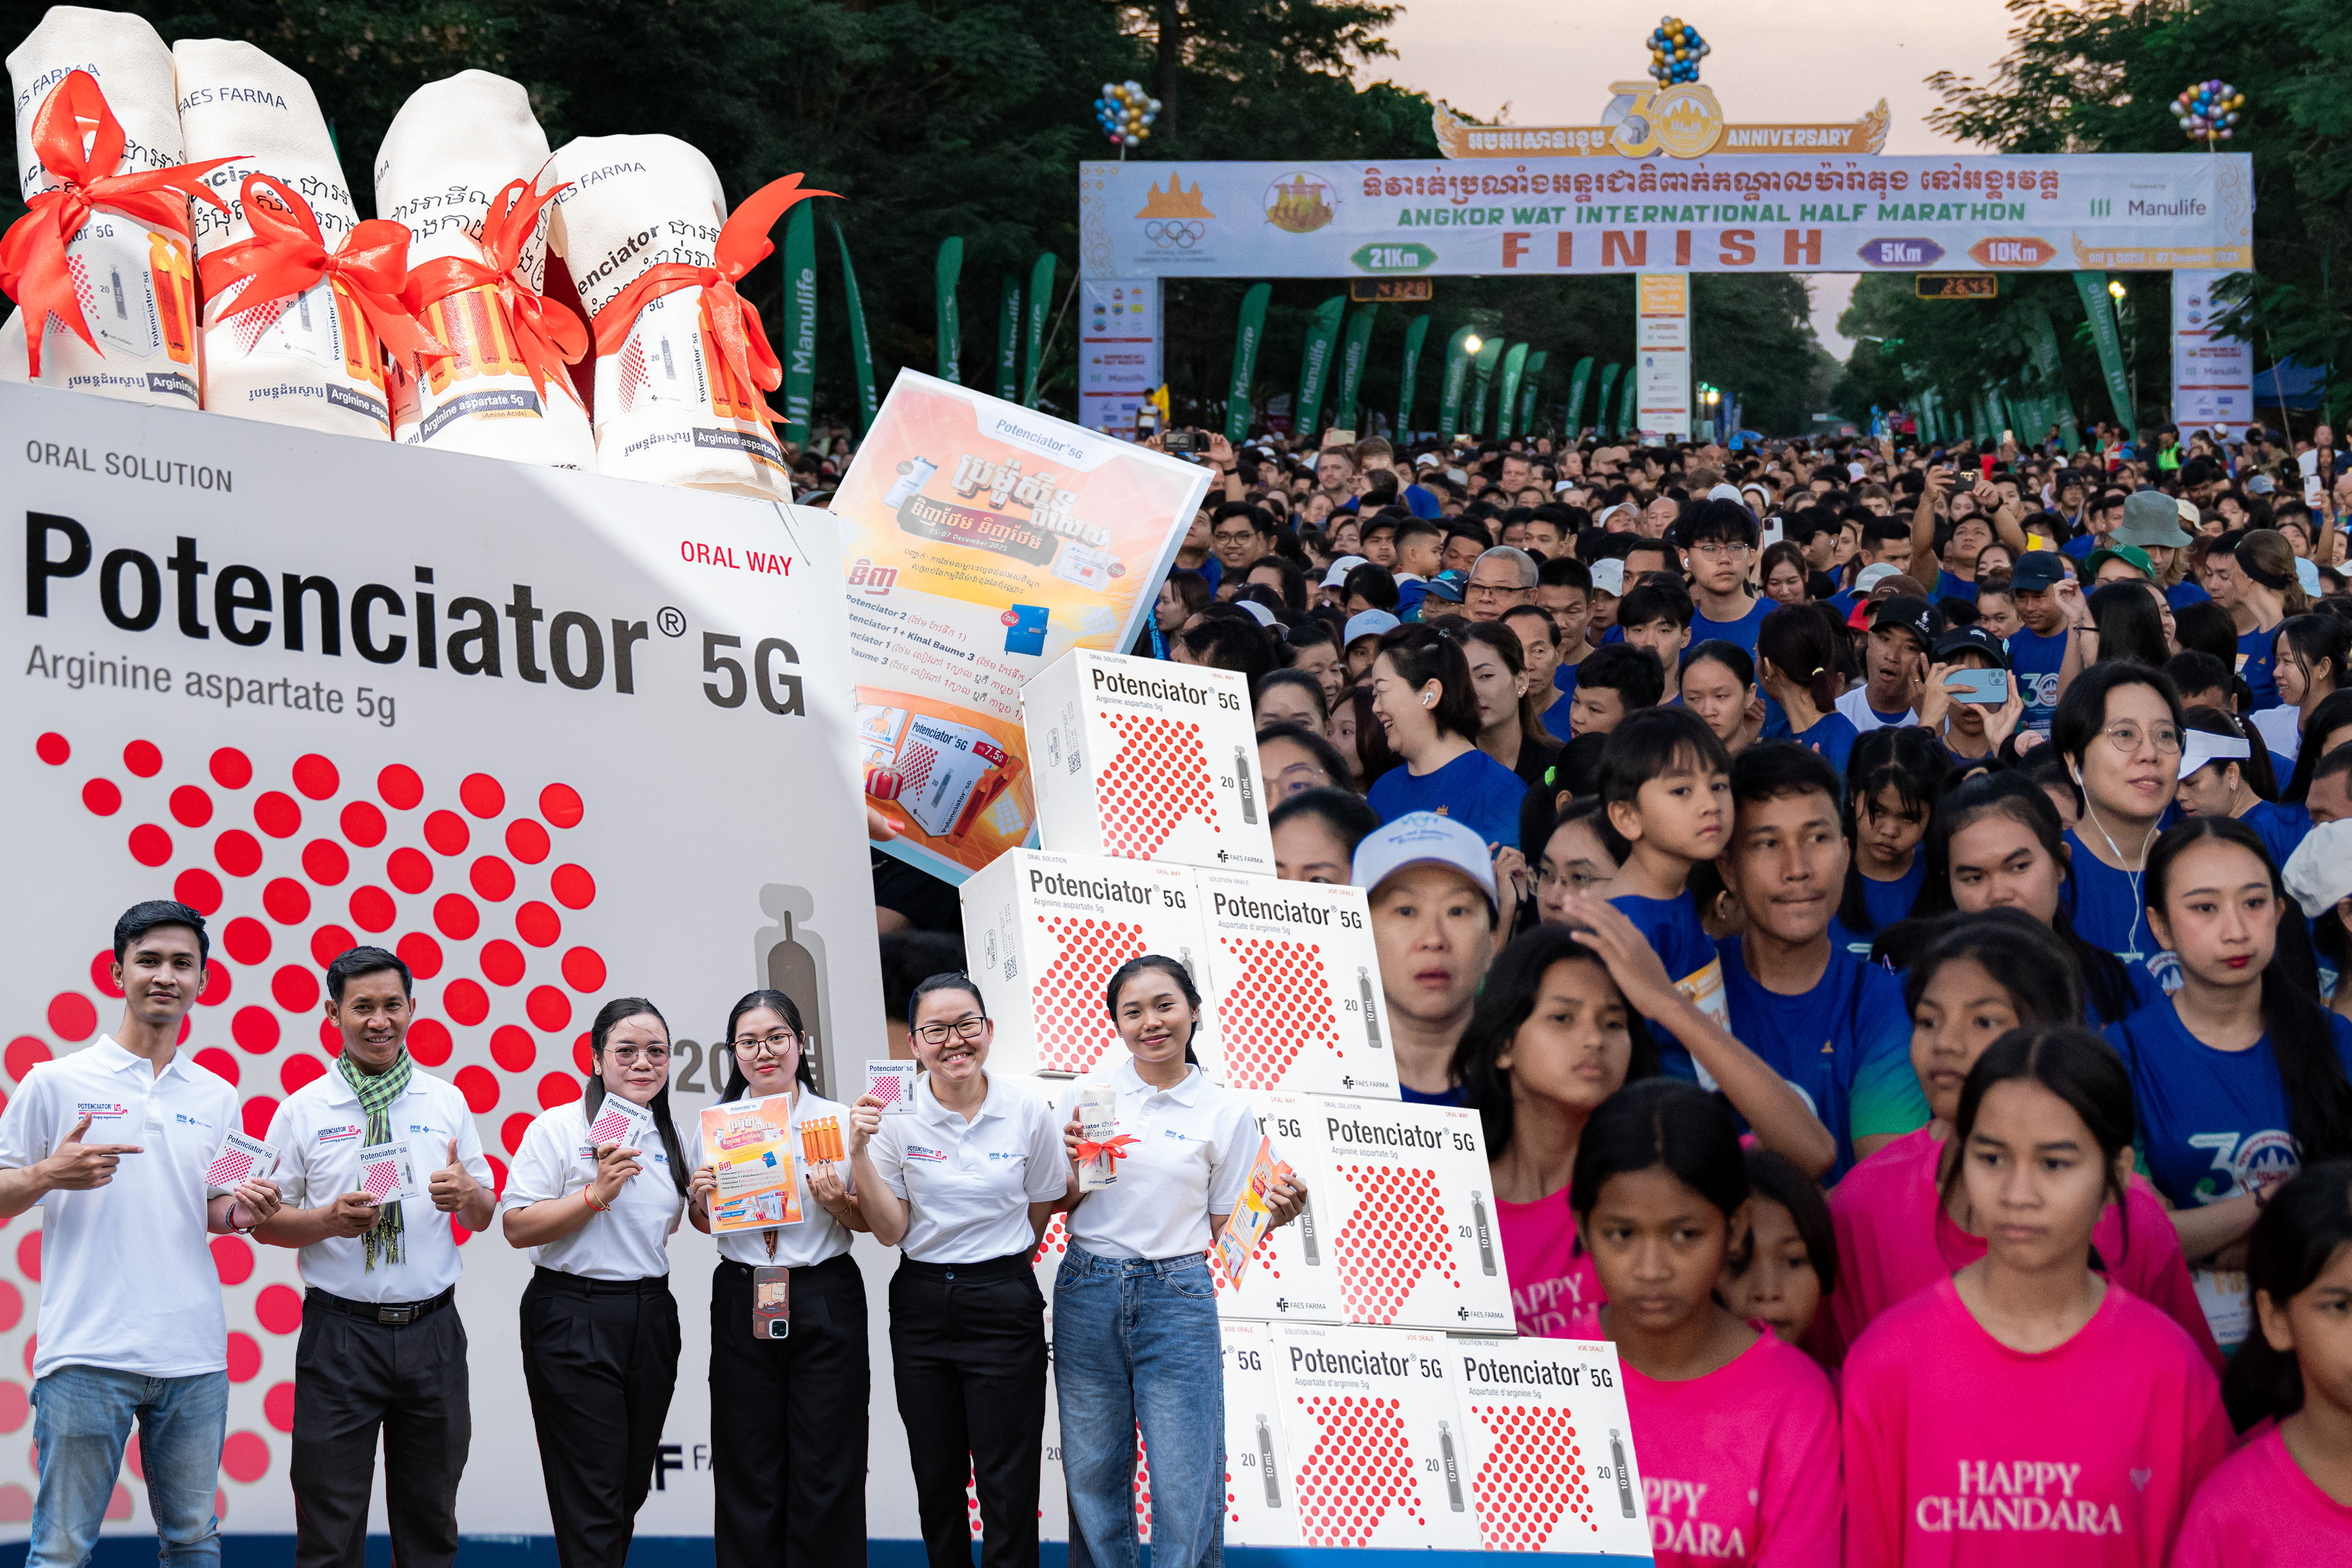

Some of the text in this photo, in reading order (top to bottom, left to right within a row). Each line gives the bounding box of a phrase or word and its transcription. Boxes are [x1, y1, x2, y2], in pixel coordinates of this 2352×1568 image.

[220, 87, 287, 110] FARMA
[1727, 128, 1853, 147] ANNIVERSARY
[580, 162, 647, 188] FARMA
[1397, 203, 2025, 227] ANGKOR WAT INTERNATIONAL HALF MARATHON
[2129, 198, 2207, 216] Manulife
[97, 224, 114, 238] 5G
[1370, 248, 1419, 267] 21Km
[1502, 229, 1822, 268] FINISH
[1881, 242, 1922, 263] 5Km
[1988, 242, 2037, 262] 10Km
[578, 225, 659, 296] enciator
[791, 267, 815, 374] Manulife
[331, 389, 369, 411] Arginine
[424, 394, 525, 434] Arginine aspartate 5g
[697, 432, 777, 458] Arginine aspartate
[1068, 447, 1083, 460] 5G
[26, 440, 233, 493] ORAL SOLUTION
[929, 528, 1008, 552] 05-07 December 2025
[680, 540, 792, 576] ORAL WAY
[899, 611, 907, 620] 2
[1915, 619, 1929, 633] POLO
[848, 613, 891, 632] tenciator
[907, 632, 931, 646] Kinal
[933, 641, 966, 658] Baume
[967, 652, 976, 662] 3
[1103, 656, 1127, 665] SOLUTION
[702, 630, 805, 717] 5G
[26, 644, 396, 726] Arginine aspartate 5g
[1096, 695, 1163, 712] Arginine aspartate 5g
[1218, 692, 1241, 711] 5G
[955, 737, 968, 751] 5G
[985, 745, 1004, 763] 7.5$
[1221, 777, 1234, 788] 20
[1042, 855, 1067, 864] SOLUTION
[1244, 856, 1264, 864] FARMA
[1033, 897, 1095, 912] Arginine aspartate
[1162, 890, 1186, 909] 5G
[1218, 920, 1280, 935] Aspartate d'arginine
[1340, 910, 1362, 930] 5G
[1344, 999, 1358, 1012] 20
[318, 1126, 346, 1136] POTENCIATOR
[907, 1145, 934, 1154] POTENCIATOR
[1331, 1146, 1389, 1159] Arginine aspartate
[1453, 1133, 1476, 1153] 5G
[264, 1151, 273, 1159] 5G
[1512, 1273, 1584, 1317] APPY
[1485, 1311, 1505, 1320] FARMA
[1238, 1350, 1262, 1372] 5G
[1419, 1358, 1443, 1379] 5G
[1294, 1376, 1359, 1390] Aspartate d'arginine
[1590, 1367, 1614, 1389] 5G
[1425, 1458, 1440, 1473] 20
[1597, 1466, 1611, 1479] 20
[1957, 1459, 2081, 1496] HAPPY
[1643, 1477, 1708, 1518] PPY
[1916, 1496, 2123, 1536] CHANDARA
[1650, 1514, 1745, 1559] DARA
